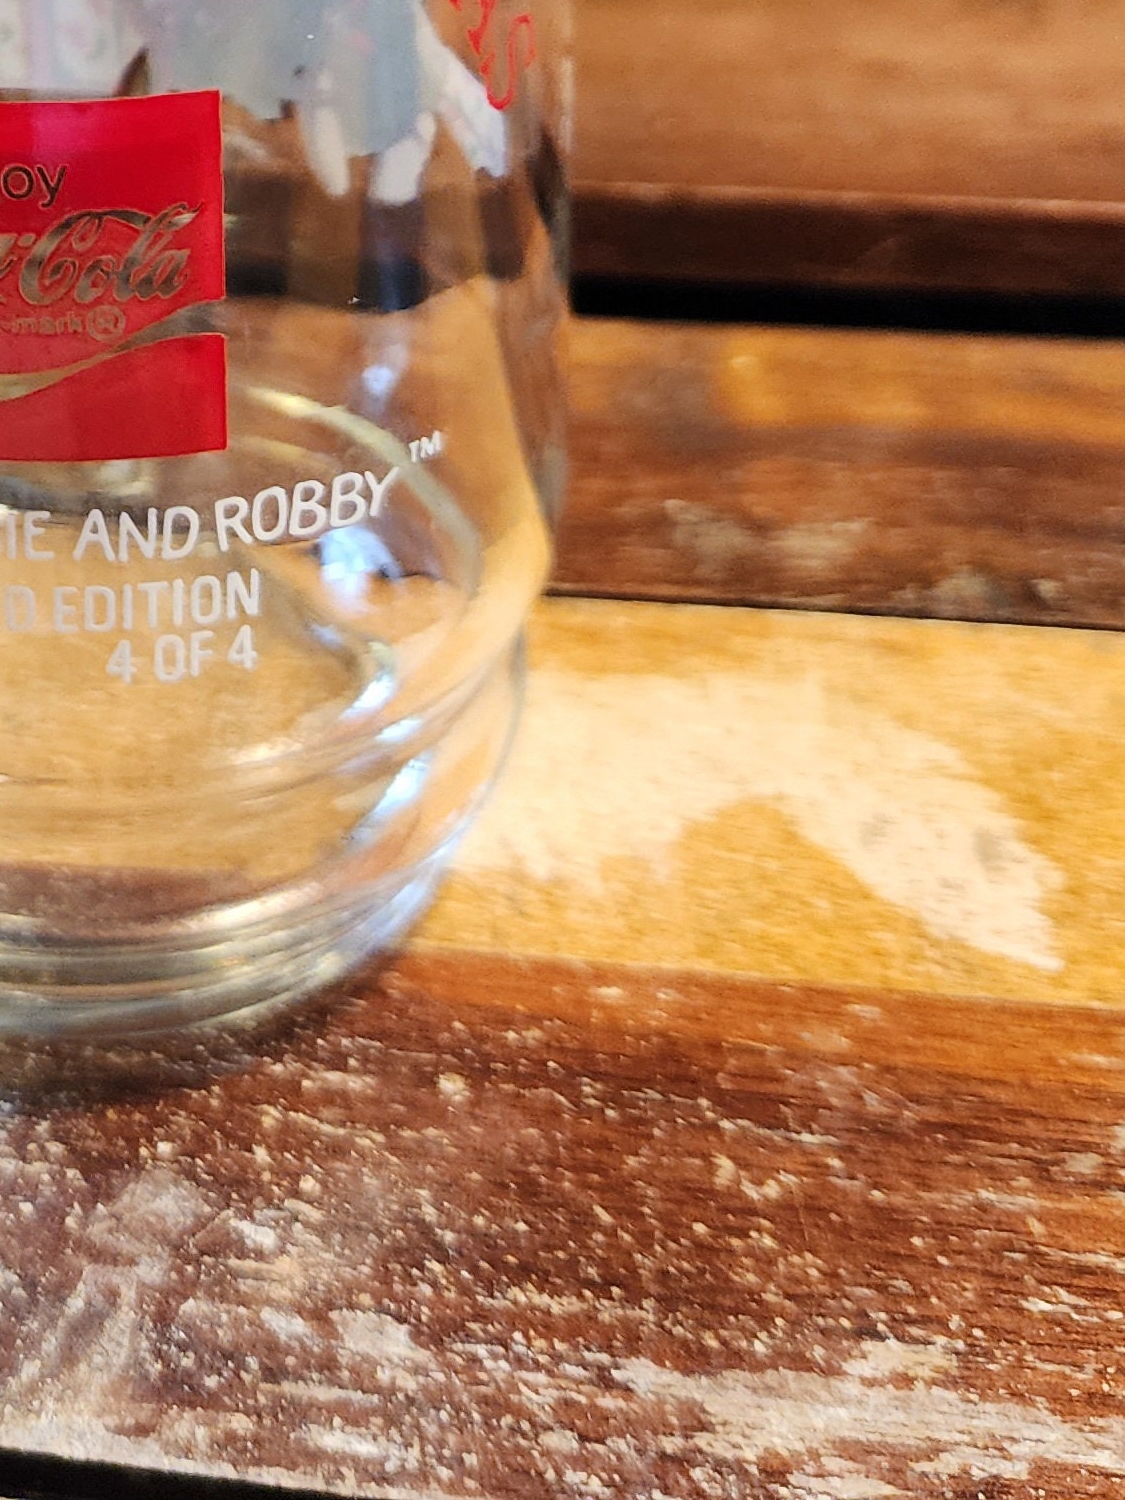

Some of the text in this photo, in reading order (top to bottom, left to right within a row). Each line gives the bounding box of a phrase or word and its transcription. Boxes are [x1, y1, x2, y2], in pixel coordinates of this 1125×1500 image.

[72, 507, 200, 563] AND
[214, 466, 401, 553] ROBBY
[52, 568, 262, 634] EDITION
[105, 638, 138, 684] 4
[153, 629, 216, 683] OF
[227, 623, 260, 671] 4
